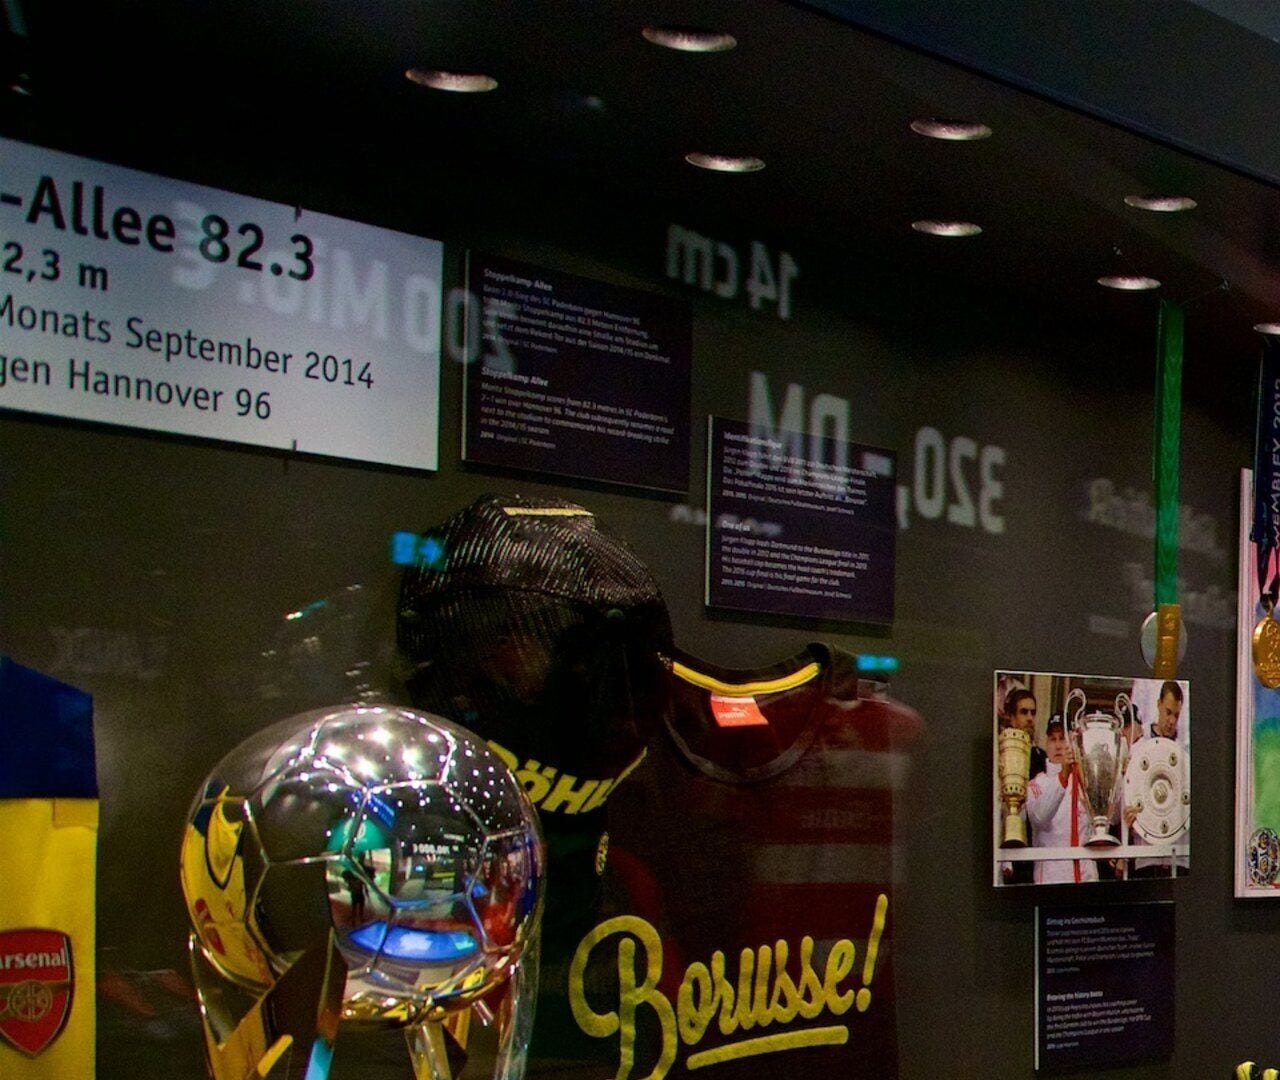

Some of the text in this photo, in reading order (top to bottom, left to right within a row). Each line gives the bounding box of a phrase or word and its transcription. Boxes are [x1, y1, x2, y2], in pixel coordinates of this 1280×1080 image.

[4, 241, 109, 291] 2,3 m
[199, 213, 316, 281] 82.3
[126, 317, 293, 386] September
[304, 351, 375, 391] 2014
[68, 358, 224, 412] Hannover
[235, 388, 272, 422] 96
